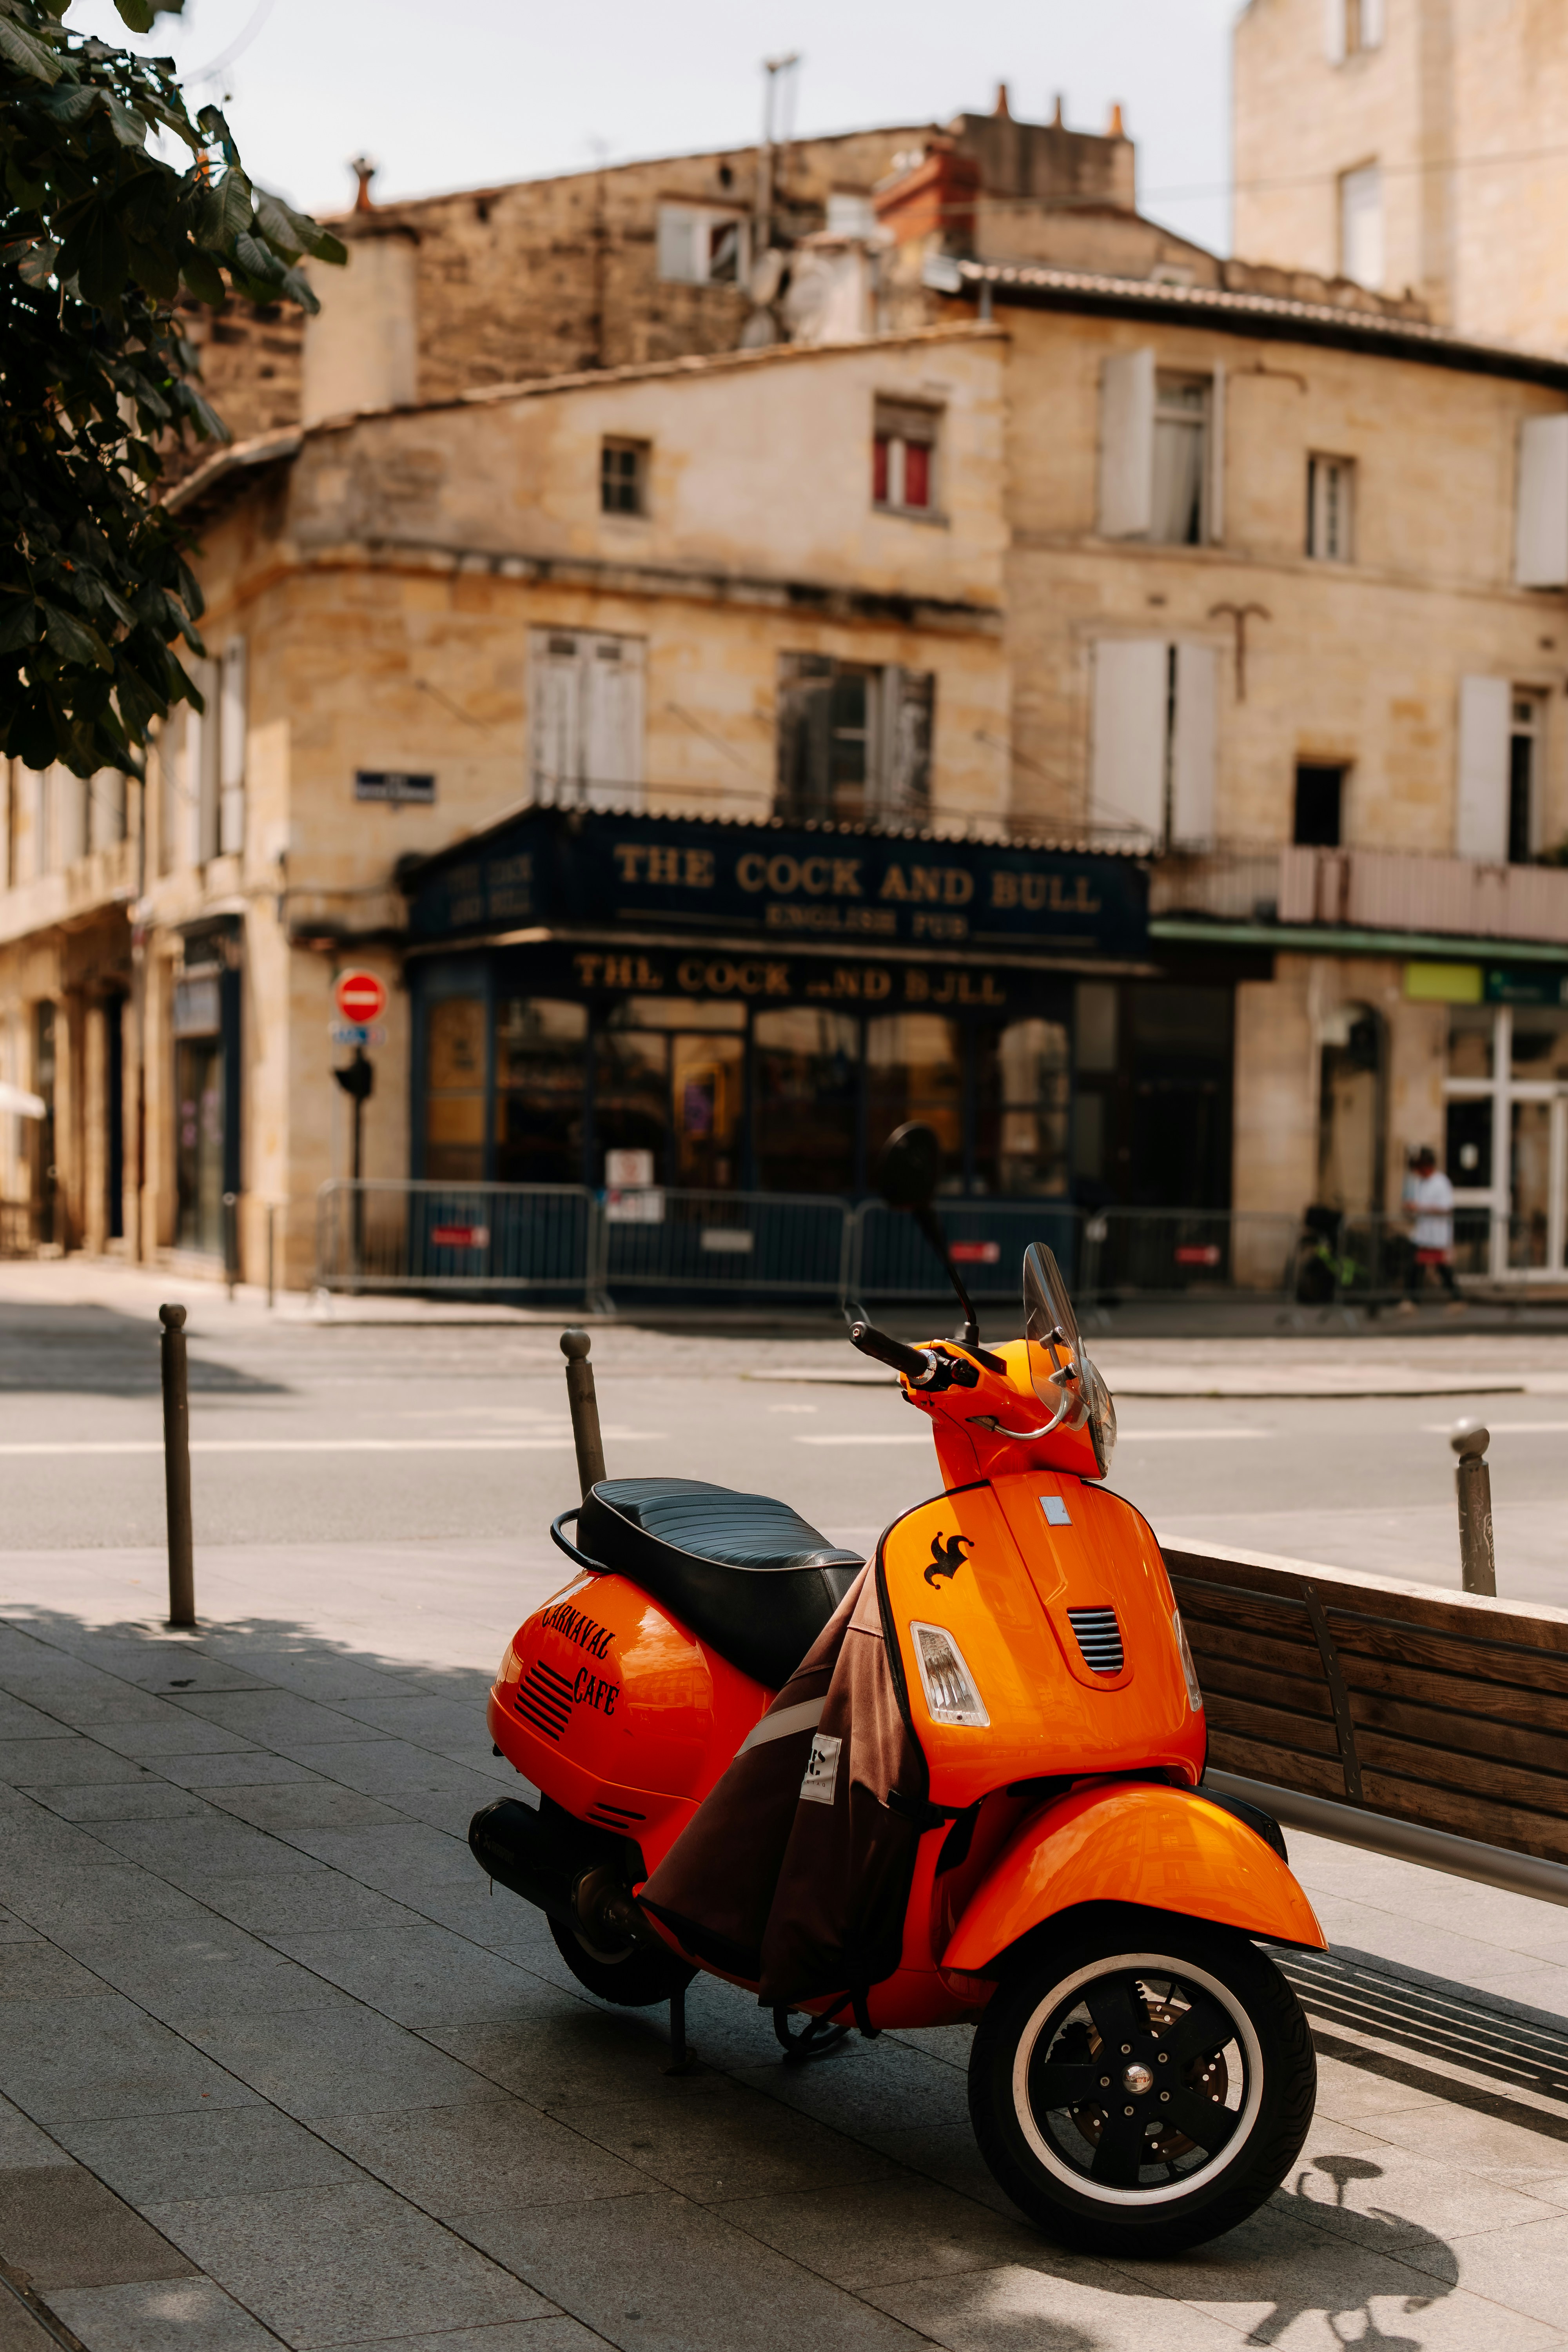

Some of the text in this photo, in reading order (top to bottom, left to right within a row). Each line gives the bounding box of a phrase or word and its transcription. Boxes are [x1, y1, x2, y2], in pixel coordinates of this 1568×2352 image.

[615, 843, 1100, 913] THE COCK AND BULL
[766, 903, 897, 934] ENGLISH
[677, 959, 791, 995] COCK
[542, 1602, 615, 1659] CARNAVAL
[573, 1667, 620, 1715] CAFÉ
